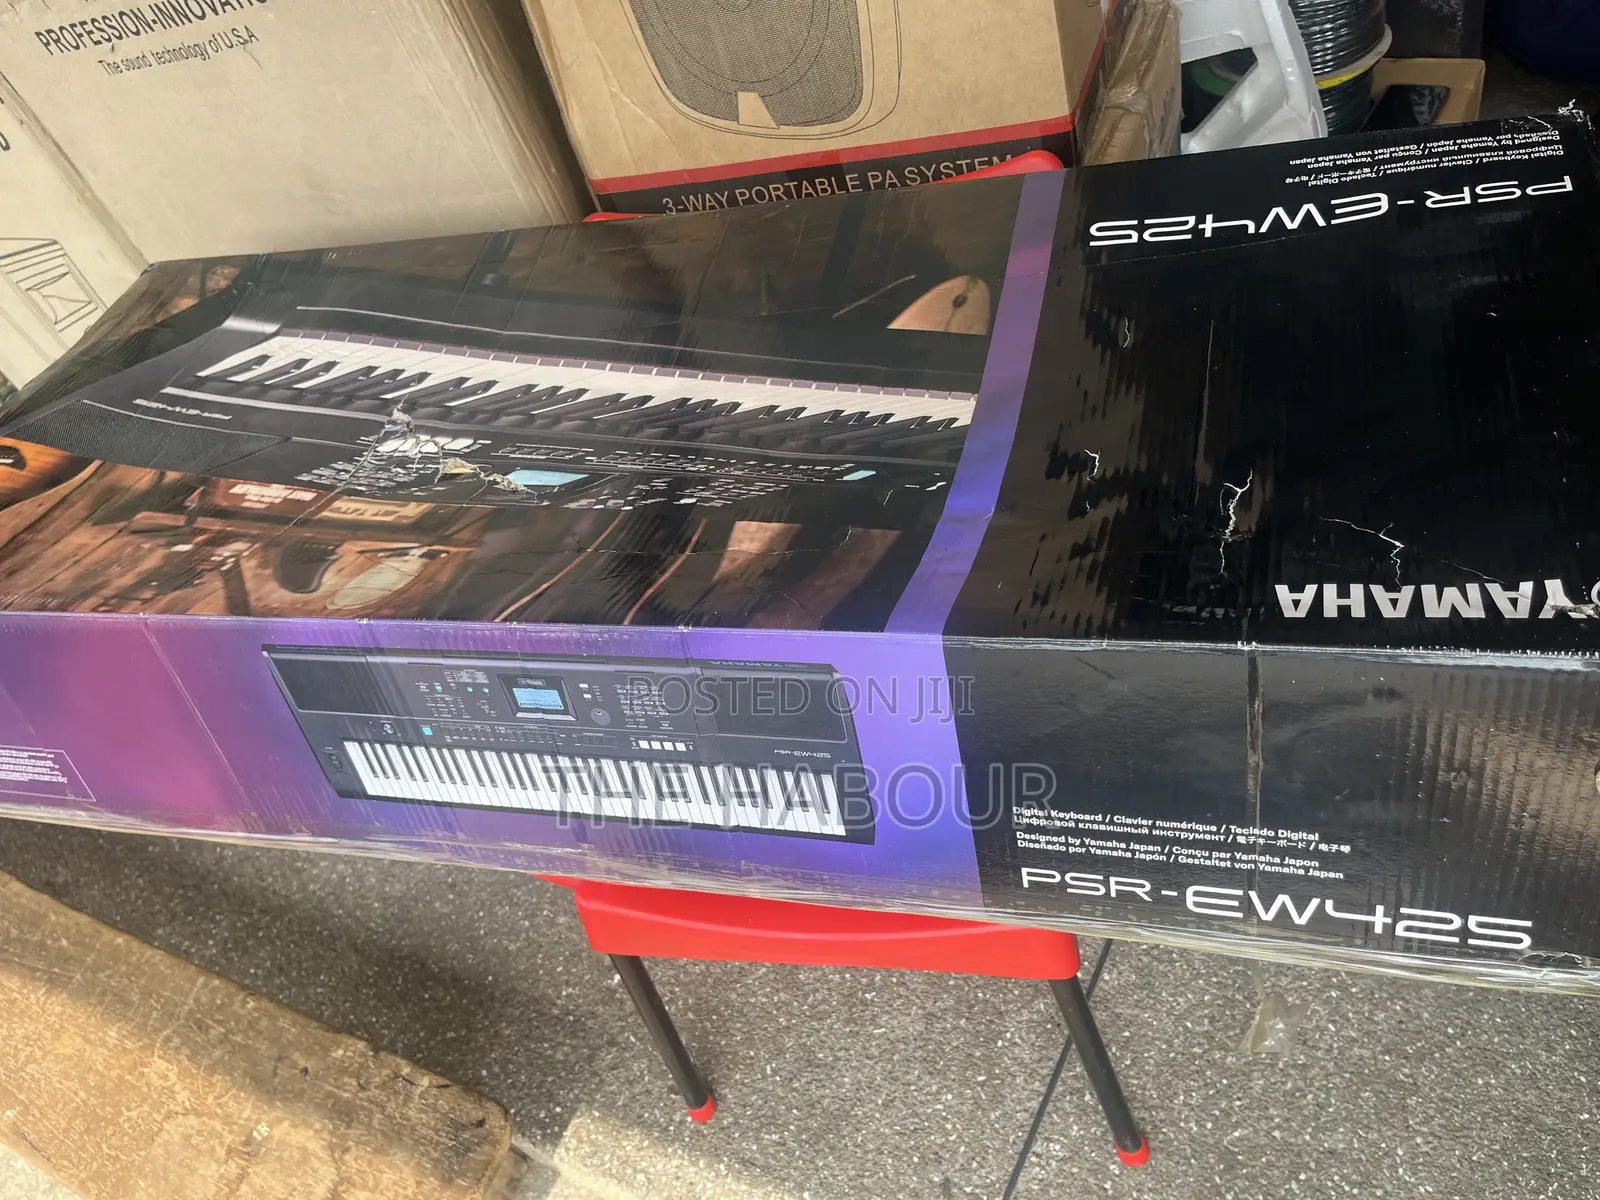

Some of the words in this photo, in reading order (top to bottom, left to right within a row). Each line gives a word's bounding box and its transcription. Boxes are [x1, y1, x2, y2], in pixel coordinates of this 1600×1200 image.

[34, 0, 267, 55] PROFESSION-INNOVA
[98, 59, 122, 76] The
[121, 52, 152, 71] sound
[150, 40, 210, 66] technology
[208, 33, 223, 53] of
[1456, 136, 1494, 144] Yamaha
[1501, 138, 1512, 146] by
[1515, 135, 1560, 145] Designed
[1432, 144, 1458, 153] Japan
[1461, 141, 1499, 150] Yamaha
[1318, 152, 1354, 162] Yamaha
[1374, 152, 1390, 160] par
[1482, 154, 1528, 163] Keyboard
[1532, 150, 1564, 158] Digital
[1336, 156, 1372, 166] Yamaha
[1439, 160, 1473, 168] Clavier
[1308, 178, 1338, 186] Digital
[1340, 172, 1377, 182] Teclado
[662, 191, 730, 215] 3-WAY
[735, 173, 862, 208] PORTABLE
[867, 170, 901, 190] PA
[1089, 176, 1573, 247] PSR-EW425
[1274, 579, 1588, 619] YAMAHA
[1012, 806, 1048, 818] Digital
[1050, 810, 1102, 822] Keyboard
[1114, 814, 1153, 826] Clavier
[1156, 819, 1218, 832] numérique
[1229, 825, 1276, 836] Teclado
[1278, 829, 1320, 841] Digital
[1013, 815, 1076, 829] Цифровой
[1078, 821, 1149, 834] клавишный
[1152, 828, 1226, 842] инструмент
[1016, 831, 1066, 843] Designed
[1068, 836, 1081, 846] by
[1082, 838, 1126, 849] Yamaha
[1128, 842, 1161, 852] Japan
[1172, 845, 1209, 858] Conçu
[1212, 851, 1232, 860] par
[1234, 852, 1280, 864] Yamaha
[1283, 856, 1320, 868] Japon
[1017, 840, 1066, 852] Diseñado
[1068, 846, 1087, 854] por
[1088, 846, 1132, 858] Yamaha
[1134, 851, 1167, 862] Japón
[1178, 855, 1232, 868] Gestaltet
[1234, 862, 1255, 870] von
[1257, 862, 1305, 875] Yamaha
[1307, 868, 1344, 879] Japan
[1021, 868, 1533, 950] PSR-EW425
